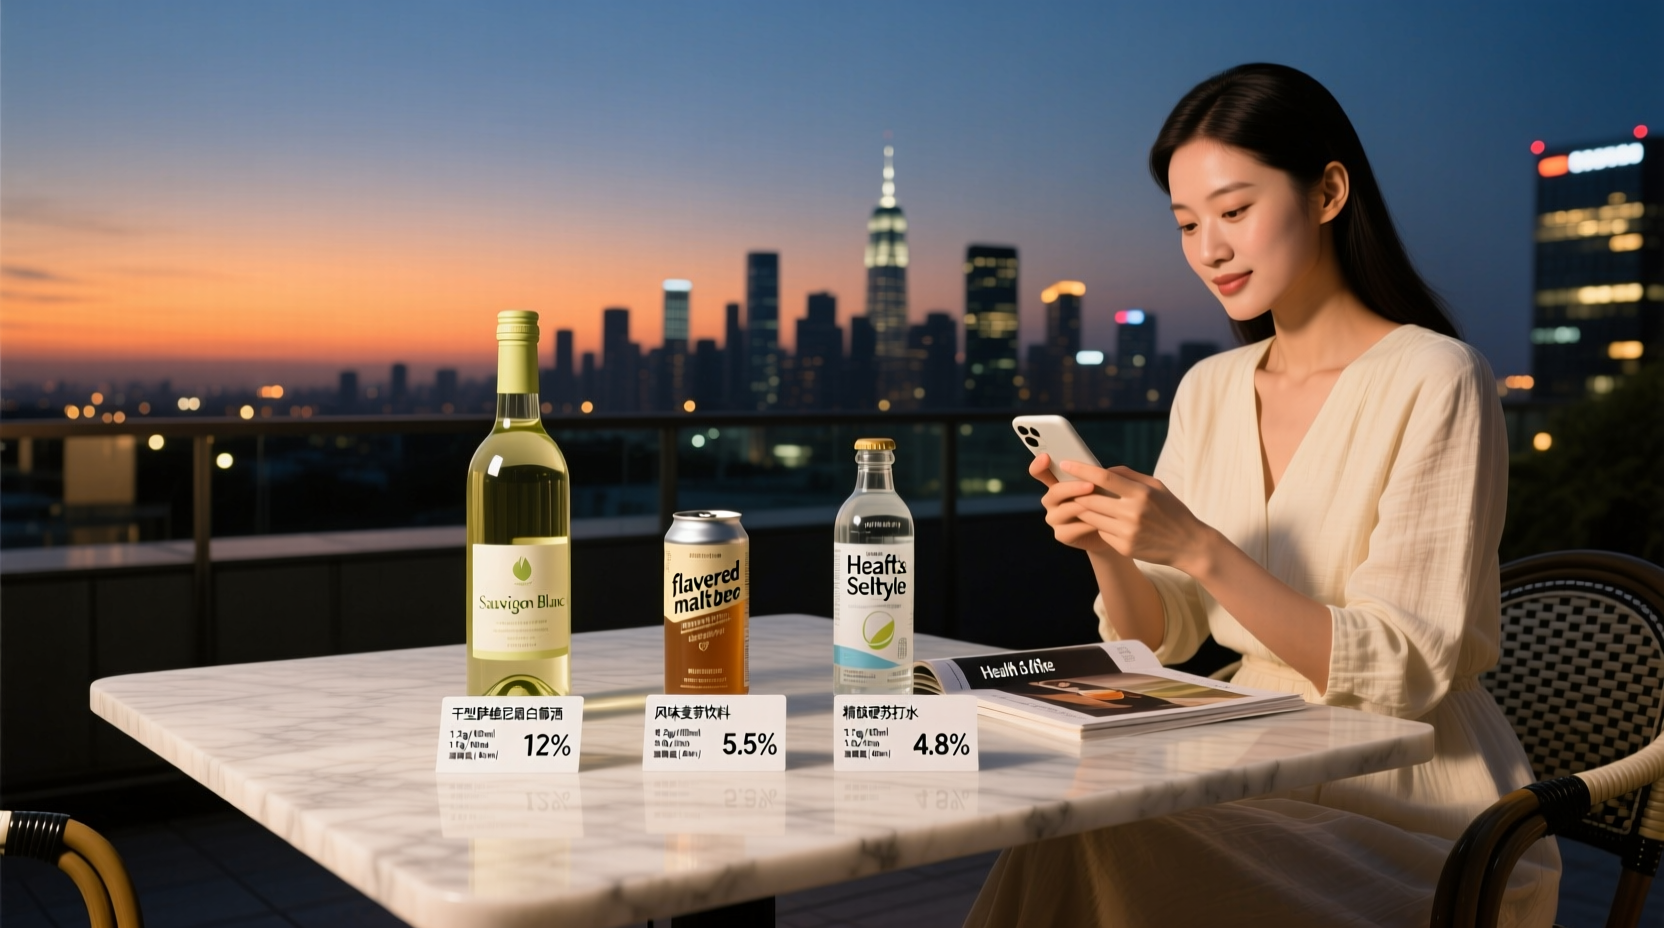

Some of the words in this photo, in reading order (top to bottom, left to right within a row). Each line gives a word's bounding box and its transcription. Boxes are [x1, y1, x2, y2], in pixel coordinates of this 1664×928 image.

[672, 559, 740, 598] flavered
[523, 733, 571, 757] 12%
[722, 732, 778, 756] 5.5%
[913, 732, 970, 756] 4.8%
